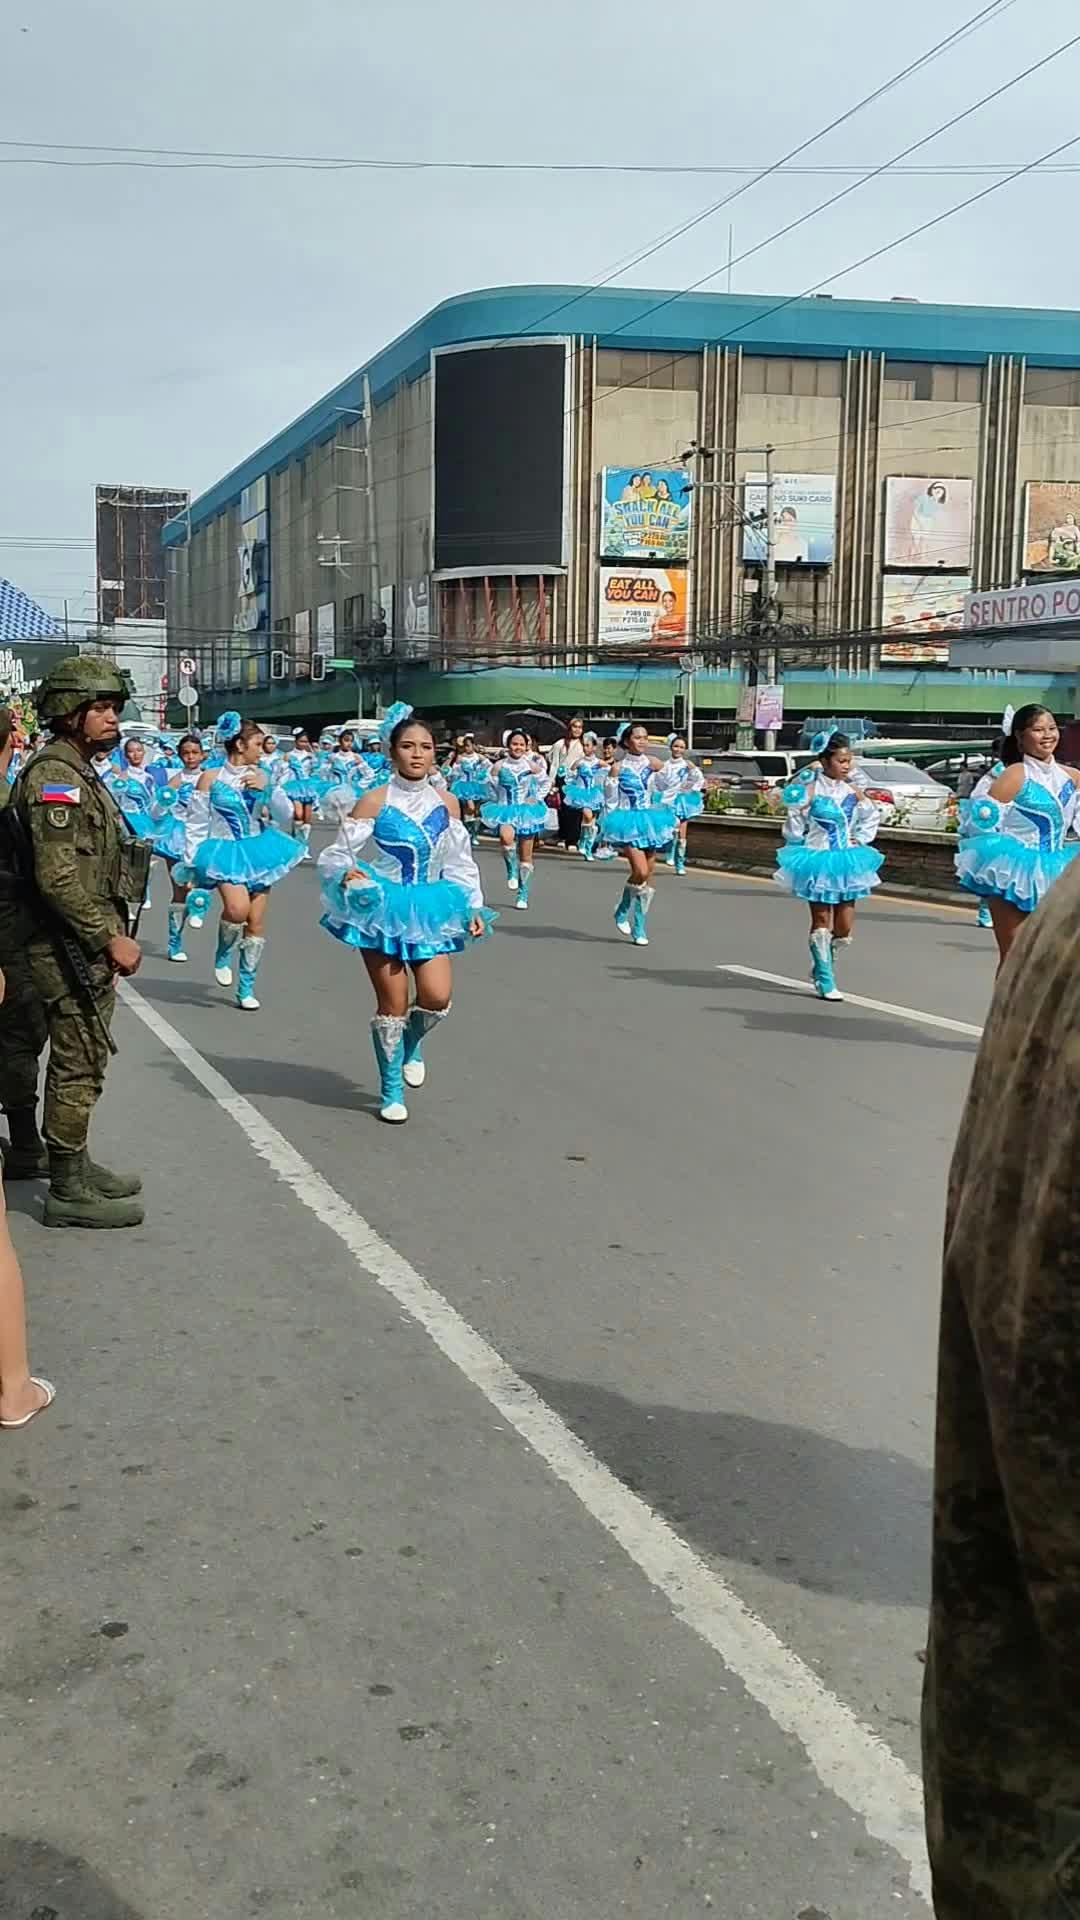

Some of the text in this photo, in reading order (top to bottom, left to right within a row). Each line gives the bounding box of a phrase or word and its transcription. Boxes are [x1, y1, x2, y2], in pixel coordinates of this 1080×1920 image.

[609, 579, 655, 590] EAT ALL
[607, 589, 659, 601] YOU CAN
[970, 588, 1080, 628] SENTRO PO
